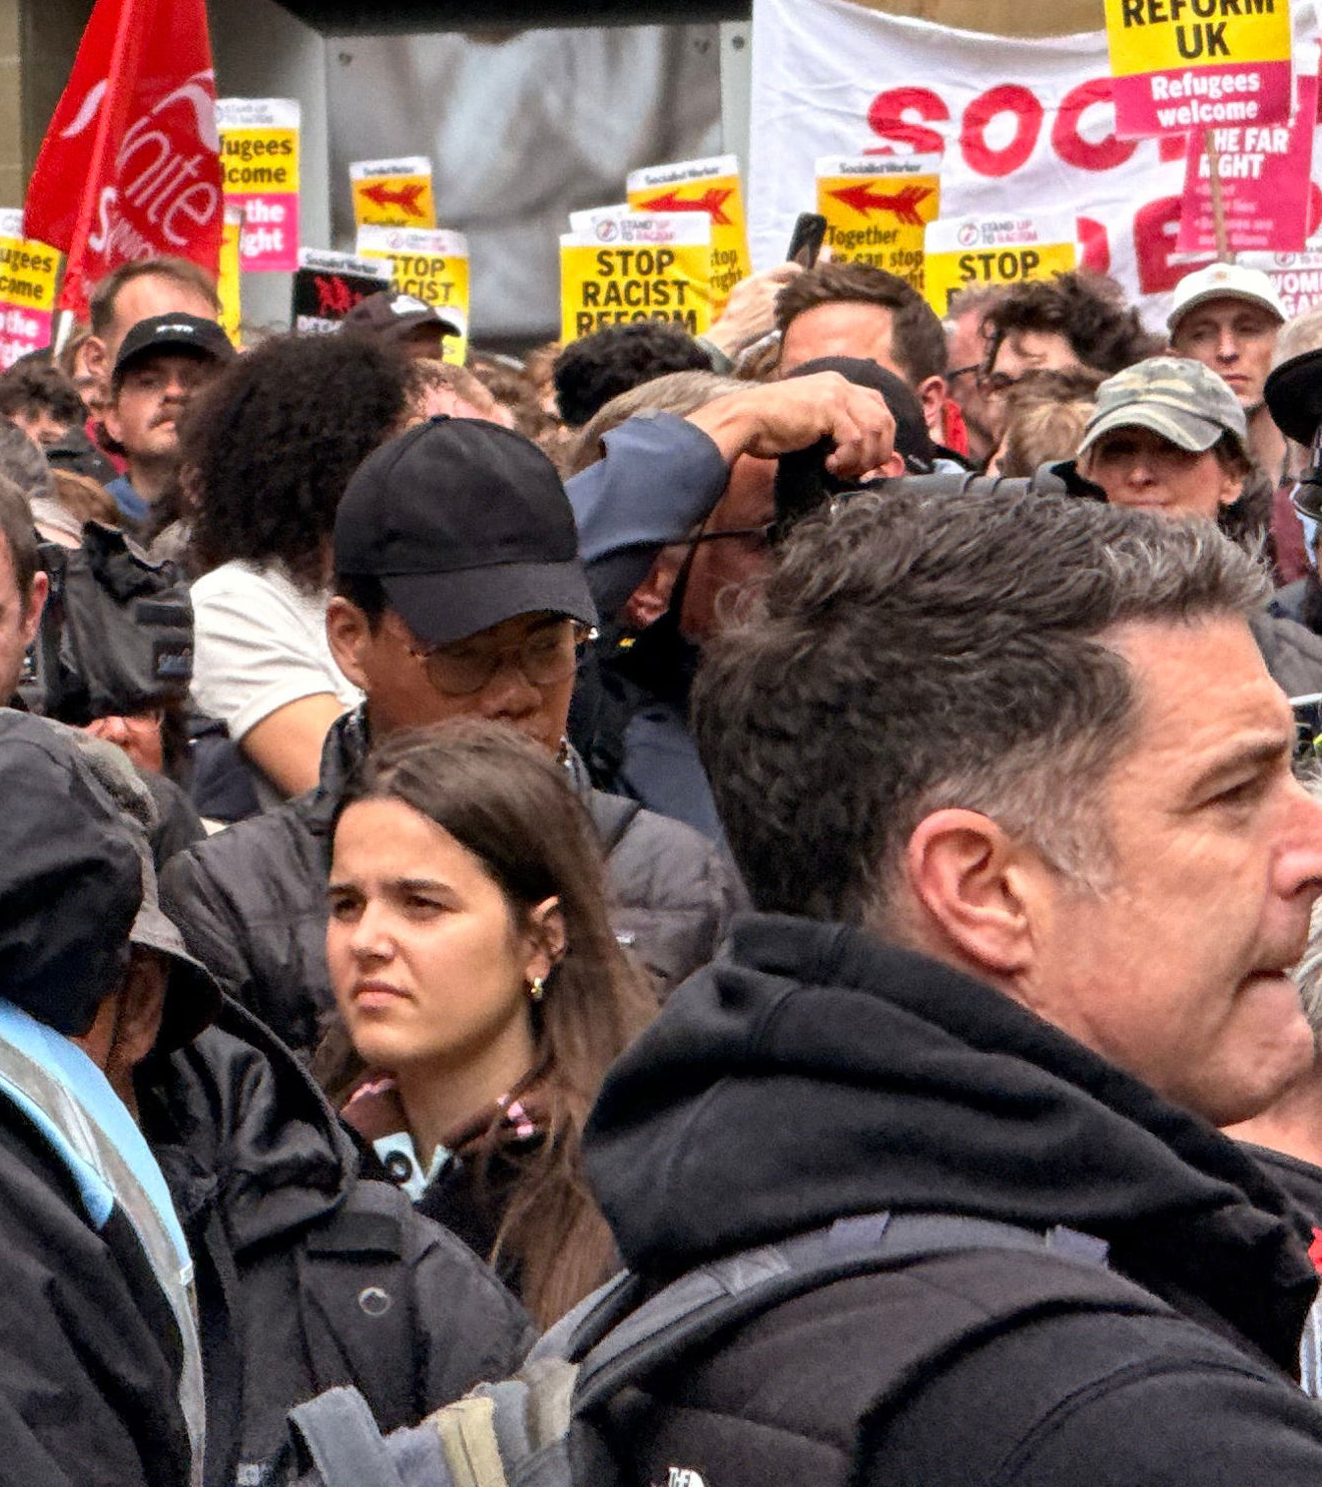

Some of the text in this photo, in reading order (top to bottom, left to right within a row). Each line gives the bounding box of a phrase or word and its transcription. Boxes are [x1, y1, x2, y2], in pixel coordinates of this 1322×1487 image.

[1175, 23, 1231, 59] UK
[1150, 72, 1261, 100] Refugees
[1157, 100, 1260, 127] welcome
[1212, 127, 1290, 153] HE FAR
[246, 198, 285, 224] the
[827, 226, 899, 253] Together
[595, 249, 676, 277] STOP
[889, 248, 925, 269] stop
[958, 249, 1040, 282] STOP
[582, 279, 691, 308] RACIST
[9, 310, 40, 338] the
